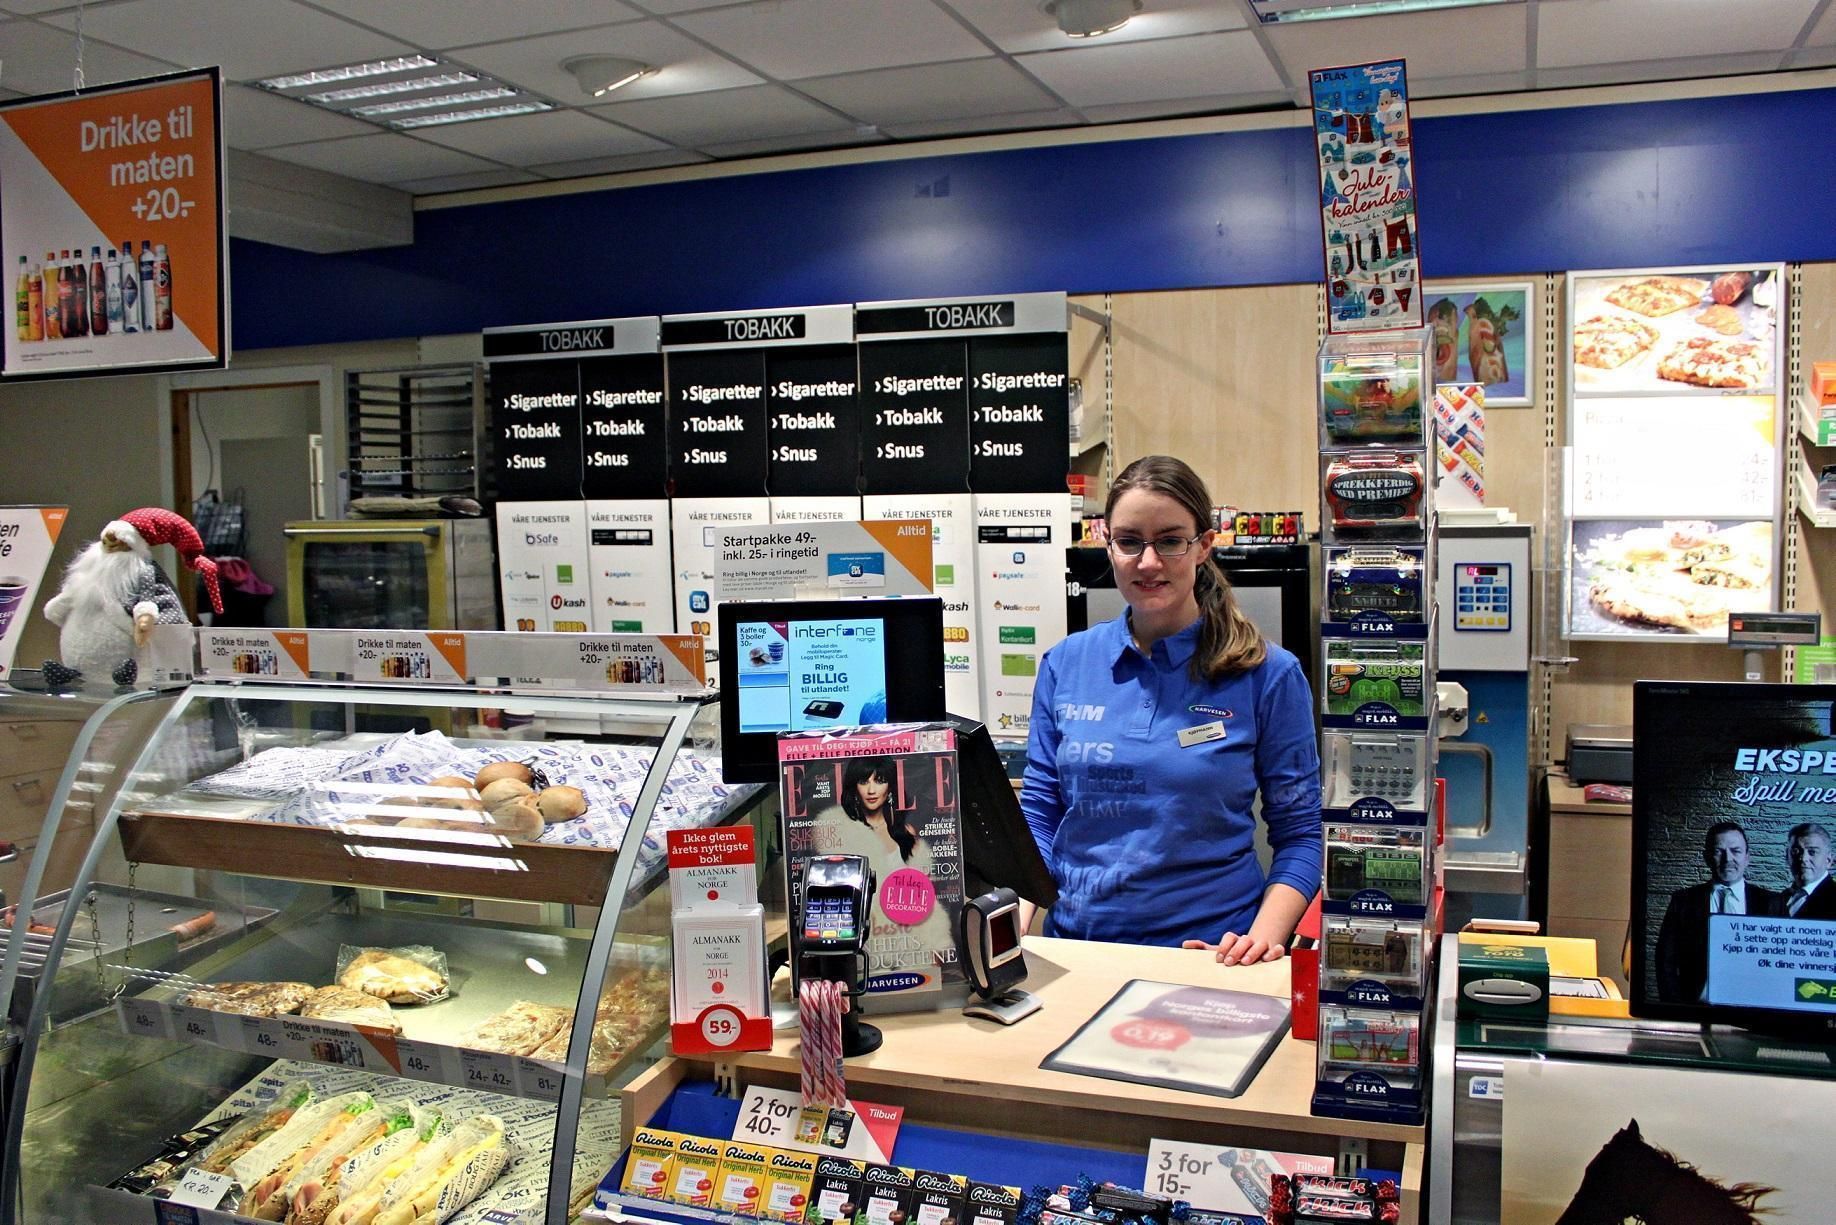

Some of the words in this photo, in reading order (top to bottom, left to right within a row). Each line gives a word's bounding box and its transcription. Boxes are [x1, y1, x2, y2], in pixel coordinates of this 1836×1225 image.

[81, 114, 162, 152] Drikke
[168, 106, 193, 139] til
[111, 153, 194, 186] maten
[1342, 167, 1393, 196] Jule-
[1332, 183, 1411, 218] kalender
[925, 304, 1003, 328] TOBAKK
[724, 316, 795, 341] TOBAKK
[540, 329, 604, 351] TOBAKK
[883, 375, 963, 396] Sigaretter
[981, 372, 1065, 392] Sigaretter
[689, 384, 762, 404] Sigaretter
[779, 381, 855, 401] Sigaretter
[510, 393, 577, 412] Sigaretter
[593, 390, 662, 408] Sigaretter
[779, 412, 835, 430] Tobakk
[883, 407, 943, 426] Tobakk
[982, 405, 1044, 423] Tobakk
[511, 422, 561, 439] Tobakk
[593, 419, 645, 436] Tobakk
[690, 415, 744, 433] Tobakk
[691, 448, 727, 464] Snus
[780, 446, 818, 462] Snus
[884, 442, 925, 459] Snus
[982, 440, 1024, 457] Snus
[513, 454, 546, 469] Snus
[594, 452, 629, 467] Snus
[512, 513, 530, 523] VÅRE
[531, 515, 570, 523] TJENESTER
[591, 512, 611, 522] VÅRE
[612, 514, 653, 522] TJENESTER
[689, 511, 709, 521] VÅRE
[710, 512, 752, 521] TJENESTER
[776, 509, 797, 520] VÅRE
[798, 511, 844, 520] TJENESTER
[897, 525, 926, 537] Alltid
[723, 533, 792, 548] Startpakke
[723, 549, 746, 561] inkl.
[770, 548, 774, 558] i
[776, 547, 819, 561] ringetid
[740, 626, 758, 635] Kaffe
[1361, 623, 1393, 631] FLAX
[211, 636, 235, 647] Drikke
[245, 637, 269, 648] maten
[358, 638, 384, 649] Drikke
[385, 638, 394, 648] til
[395, 639, 422, 649] maten
[579, 642, 609, 653] Drikke
[611, 641, 621, 653] til
[623, 643, 653, 653] maten
[815, 663, 834, 671] Ring
[802, 673, 848, 685] BILLIG
[801, 686, 810, 694] til
[811, 684, 850, 693] utlandet!
[1365, 714, 1397, 723] FLAX
[1734, 748, 1836, 774] EKSPE
[1730, 776, 1798, 806] Spill
[1361, 809, 1393, 819] FLAX
[683, 832, 706, 843] Ikke
[709, 832, 736, 843] glem
[919, 829, 956, 837] GENSERNE
[672, 844, 699, 855] årets
[700, 842, 749, 855] nyttigste
[699, 853, 723, 864] bok!
[687, 867, 738, 877] ALMANAKK
[698, 881, 728, 889] NORGE
[893, 875, 906, 887] Til
[886, 887, 929, 905] ELLE
[886, 903, 928, 913] DECORATION
[1361, 902, 1393, 911] FLAX
[1729, 922, 1740, 931] Vi
[1742, 922, 1757, 931] har
[1760, 923, 1782, 934] valgt
[1785, 925, 1795, 934] ut
[1799, 927, 1822, 935] noen
[692, 935, 741, 945] ALMANAKK
[1734, 933, 1741, 942] å
[1744, 934, 1768, 943] sette
[1770, 936, 1788, 946] opp
[1791, 937, 1834, 948] andelslag
[705, 952, 729, 960] NORGE
[1722, 943, 1743, 954] Kjøp
[1745, 945, 1758, 954] din
[1761, 946, 1786, 955] andel
[1789, 947, 1806, 956] hos
[1809, 947, 1830, 957] våre
[1757, 959, 1771, 968] Øk
[1775, 959, 1795, 969] dine
[707, 968, 728, 979] 2014
[1358, 992, 1390, 1002] FLAX
[1162, 1000, 1213, 1012] Norges
[1216, 1005, 1271, 1020] billigste
[1170, 1008, 1255, 1024] kontantkort
[283, 1020, 310, 1033] Drikke
[311, 1024, 321, 1034] til
[323, 1026, 350, 1038] maten
[1355, 1083, 1387, 1094] FLAX
[749, 1096, 765, 1114] 2
[766, 1098, 798, 1119] for
[869, 1109, 897, 1120] Tilbud
[636, 1132, 674, 1148] Ricola
[679, 1140, 718, 1156] Ricola
[725, 1146, 766, 1164] Ricola
[722, 1162, 751, 1173] Original
[752, 1165, 765, 1175] Herb
[771, 1154, 813, 1170] Ricola
[819, 1160, 862, 1179] Ricola
[1157, 1151, 1173, 1172] 3
[1179, 1153, 1213, 1177] for
[1295, 1160, 1328, 1174] Tilbud
[768, 1169, 795, 1181] Original
[796, 1172, 811, 1182] Herb
[866, 1167, 911, 1187] Ricola
[826, 1179, 848, 1191] Lakris
[875, 1185, 897, 1198] Lakris
[916, 1174, 962, 1194] Ricola
[1309, 1178, 1366, 1194] kick
[501, 1188, 530, 1201] OK!
[925, 1193, 949, 1205] Lakris
[971, 1186, 1017, 1206] Ricola
[980, 1206, 1003, 1218] Lakris
